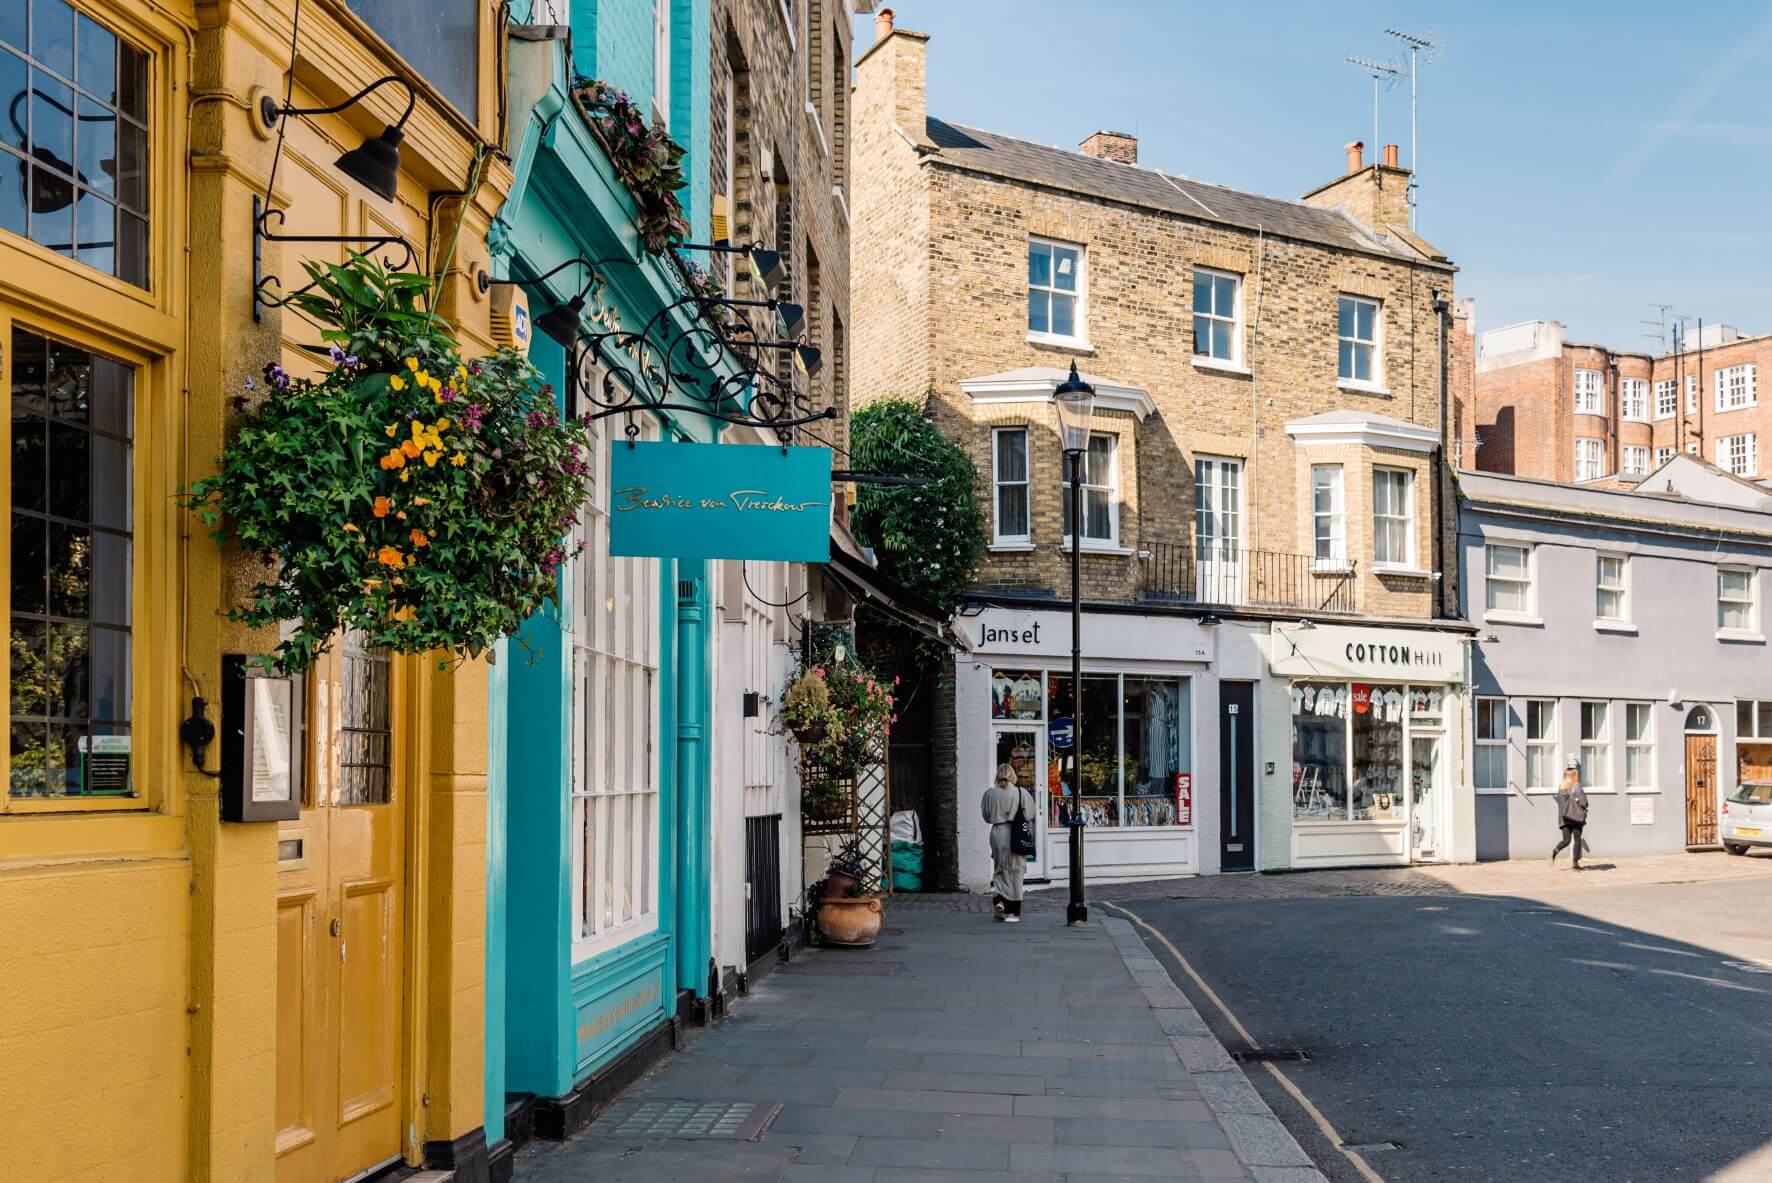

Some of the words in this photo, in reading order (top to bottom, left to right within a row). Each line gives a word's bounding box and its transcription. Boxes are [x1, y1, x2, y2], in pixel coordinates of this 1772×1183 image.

[616, 488, 693, 512] Beatrice
[699, 496, 728, 509] von
[977, 621, 1041, 648] Janset
[1345, 642, 1410, 664] COTTON
[1414, 650, 1442, 667] Hill
[1353, 690, 1368, 702] sale
[1696, 715, 1706, 726] 17
[1178, 776, 1190, 823] SALE
